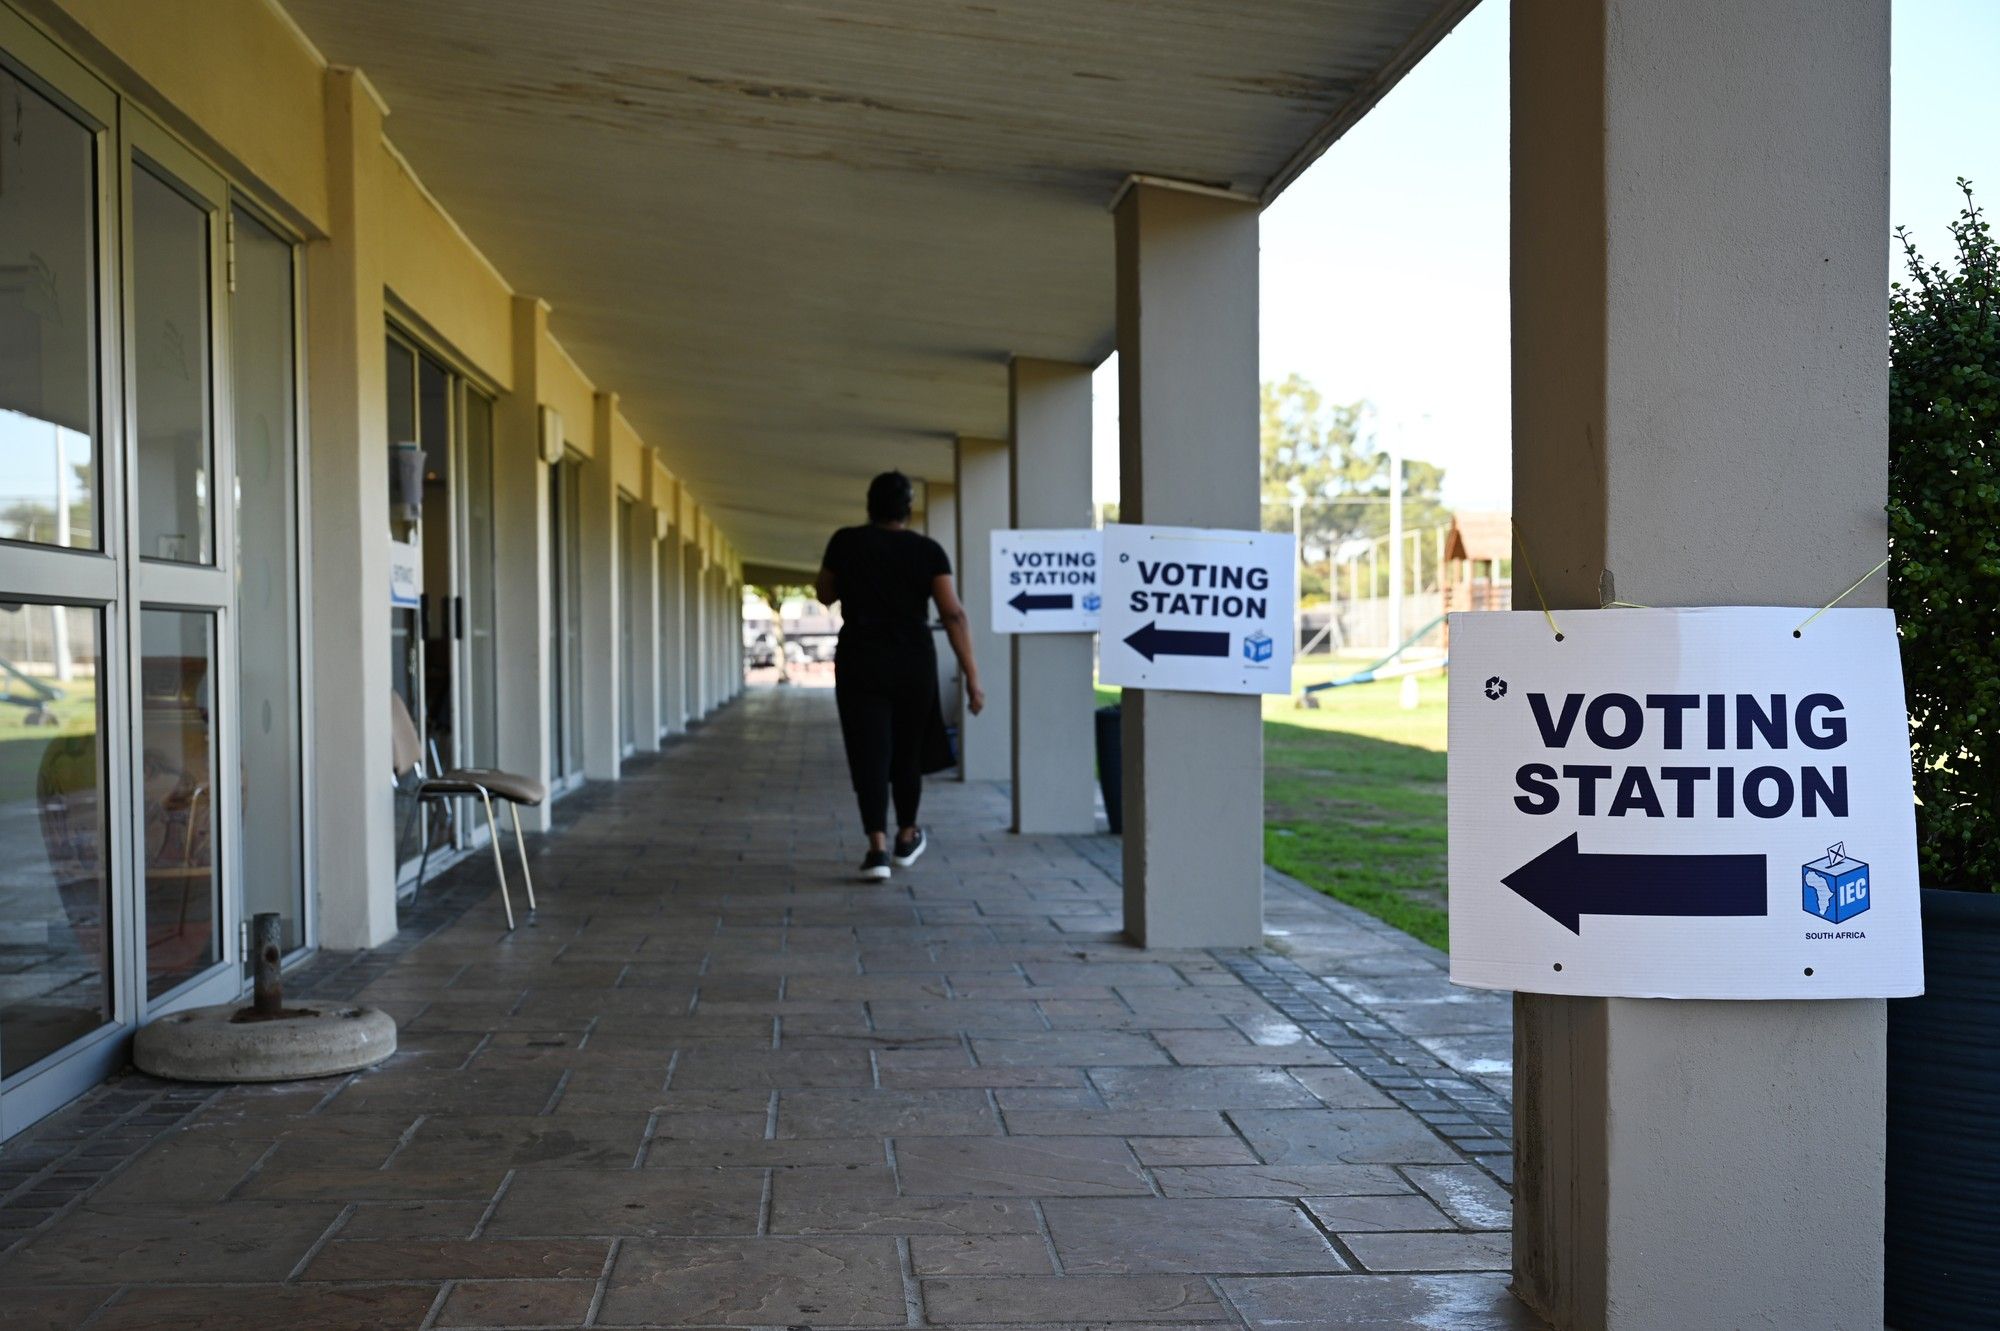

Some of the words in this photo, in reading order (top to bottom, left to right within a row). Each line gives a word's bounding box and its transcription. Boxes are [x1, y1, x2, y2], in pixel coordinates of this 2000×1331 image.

[1012, 551, 1097, 568] VOTING
[1009, 570, 1097, 586] STATION
[1137, 560, 1269, 591] VOTING
[1129, 590, 1267, 619] STATION
[1526, 692, 1848, 750] VOTING
[1513, 763, 1849, 818] STATION
[1839, 877, 1867, 907] IEC
[1805, 932, 1834, 940] SOUTH
[1835, 931, 1866, 940] AFRICA
